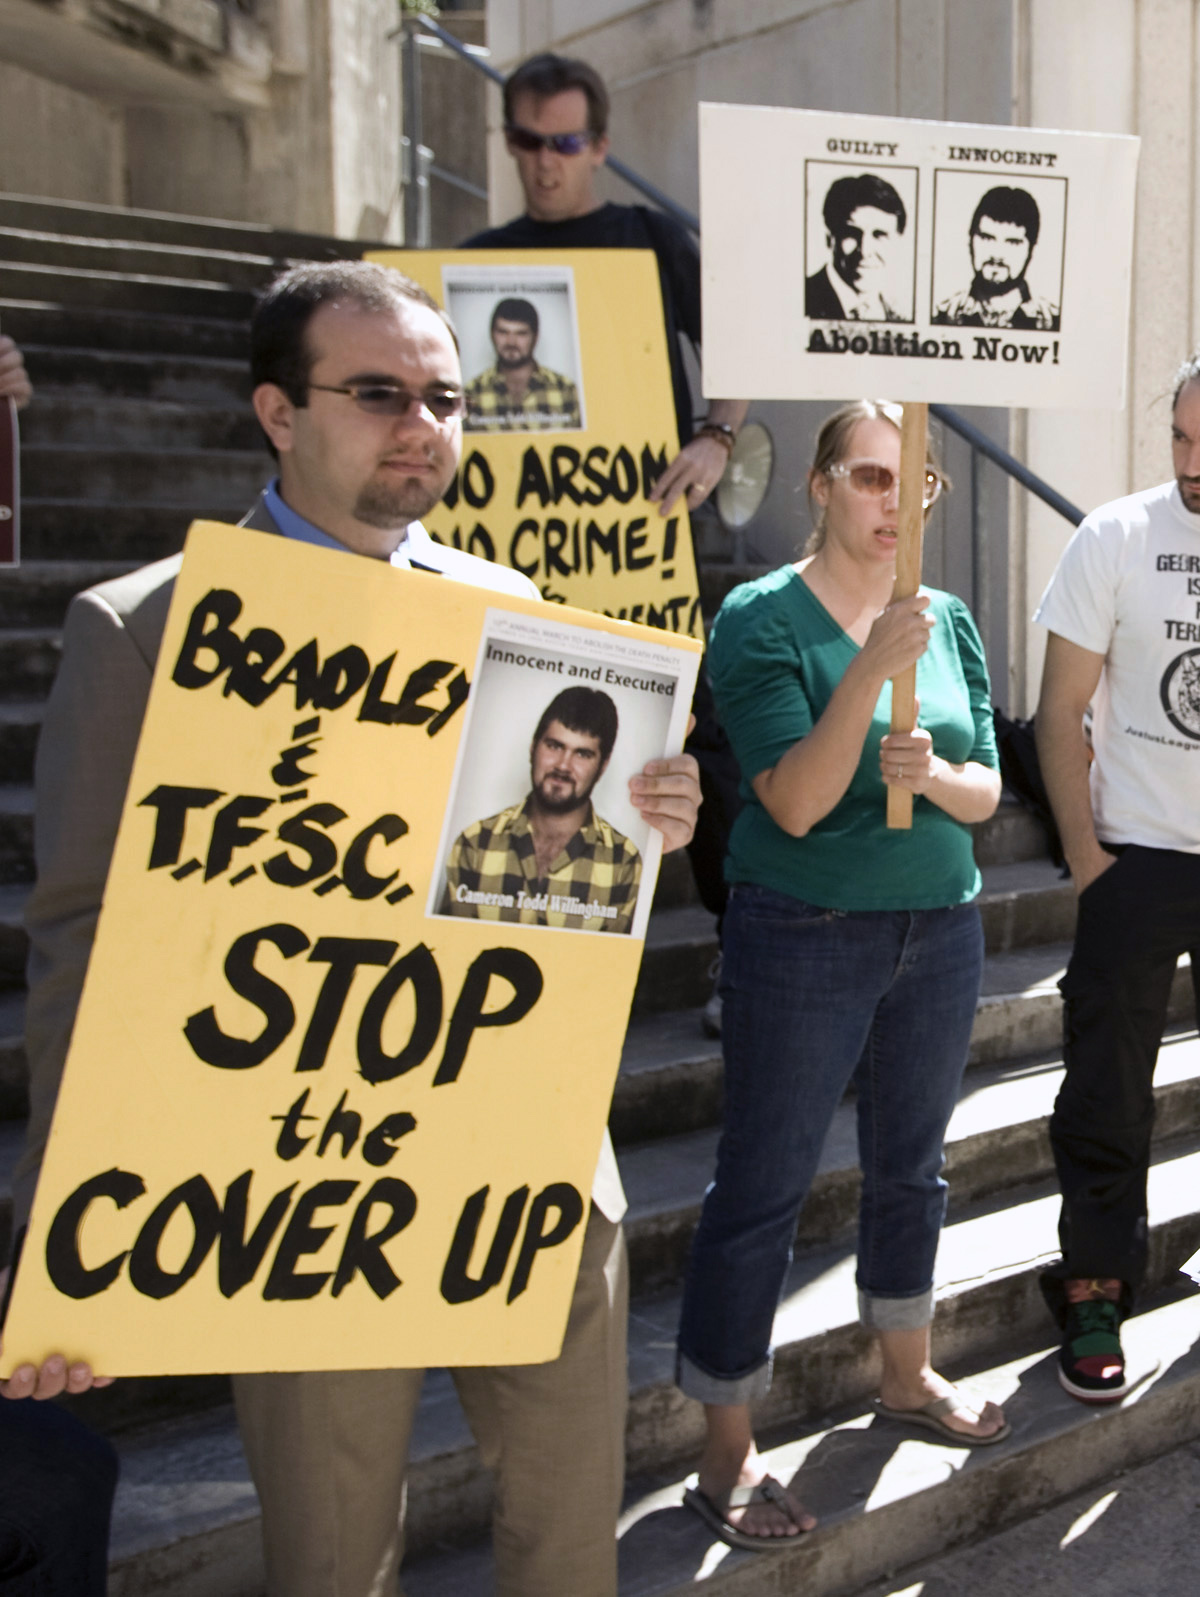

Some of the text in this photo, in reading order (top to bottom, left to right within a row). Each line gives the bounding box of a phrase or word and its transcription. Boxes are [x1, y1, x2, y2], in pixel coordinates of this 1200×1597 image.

[826, 137, 899, 158] GUILTY
[948, 146, 1058, 168] INNOCENT
[805, 328, 1061, 366] Abolition Now!
[516, 442, 669, 510] ARSON
[509, 516, 680, 581] CRIME!
[171, 588, 472, 738] BRADLEY
[486, 644, 565, 675] Innocent
[567, 663, 602, 681] and
[604, 668, 676, 697] Executed
[456, 883, 619, 920] Cameron Todd Willingham
[183, 922, 545, 1088] STOP
[269, 1087, 418, 1168] the
[45, 1166, 584, 1307] COVER UP
